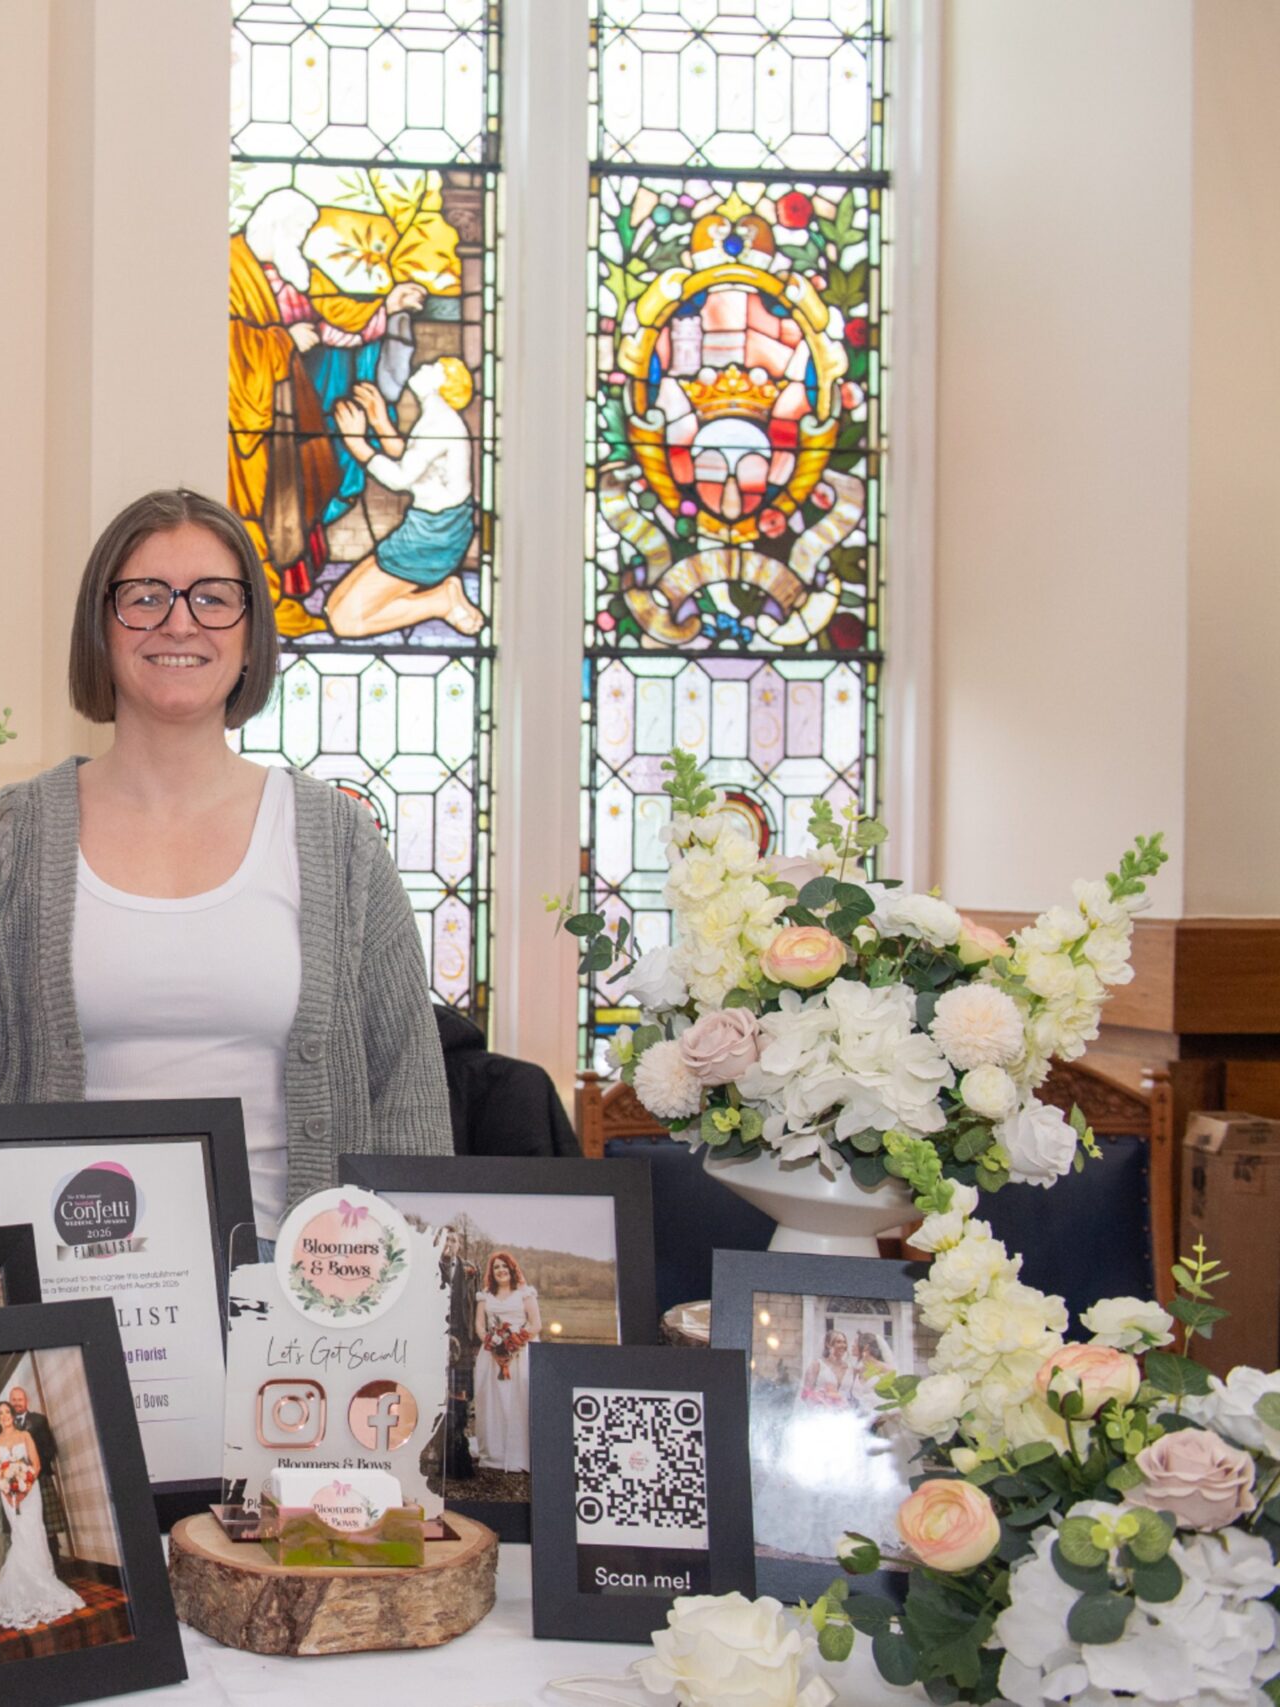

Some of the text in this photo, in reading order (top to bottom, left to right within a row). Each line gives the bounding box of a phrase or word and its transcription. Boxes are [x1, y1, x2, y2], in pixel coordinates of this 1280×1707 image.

[60, 1199, 130, 1224] Confetti
[87, 1227, 112, 1239] 2026
[73, 1239, 132, 1259] FINALIST
[302, 1238, 379, 1257] Bloomers
[310, 1260, 372, 1278] & Bows
[56, 1276, 79, 1285] proud
[139, 1270, 189, 1280] establishment
[134, 1280, 161, 1289] Awards
[135, 1347, 167, 1362] Florist
[267, 1336, 408, 1372] Let's Get Social!
[144, 1393, 169, 1408] Bows
[278, 1457, 391, 1470] Bloomers & Bows
[595, 1566, 691, 1590] Scan me!
